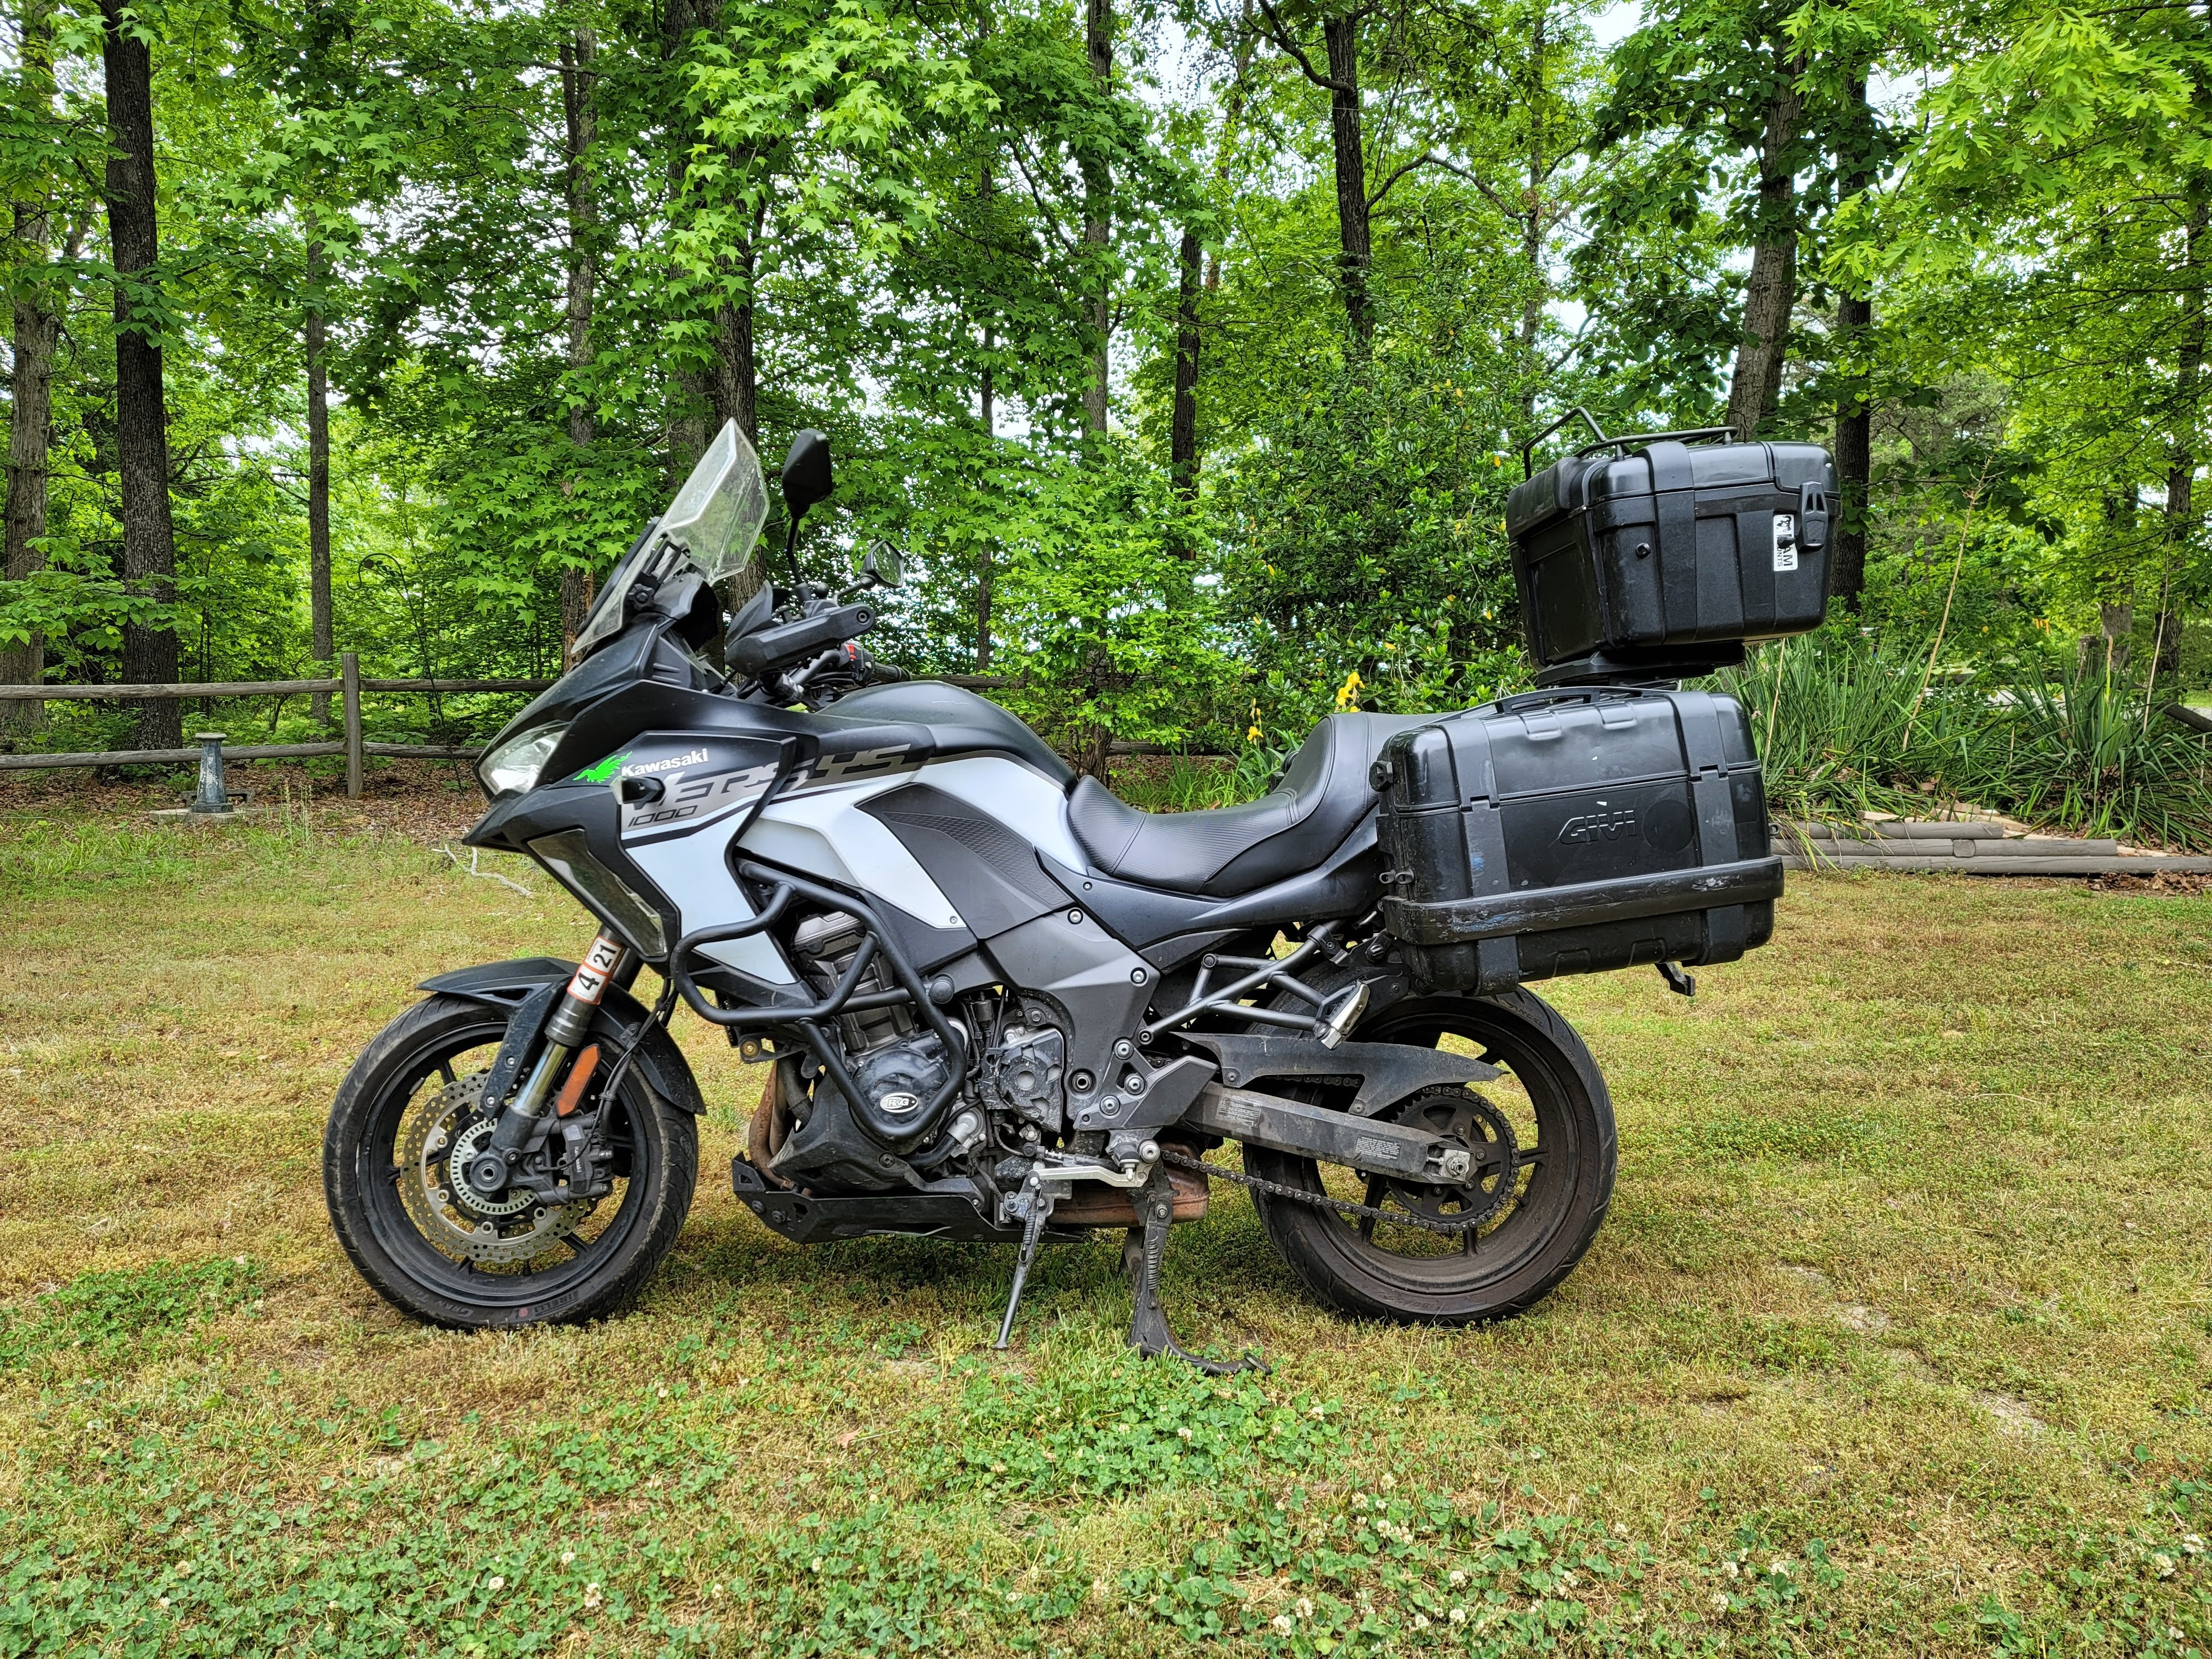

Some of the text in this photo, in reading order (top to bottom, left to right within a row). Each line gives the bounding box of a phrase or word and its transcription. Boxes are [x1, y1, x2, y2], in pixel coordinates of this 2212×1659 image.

[621, 748, 709, 777] Kawasaki
[628, 805, 698, 827] 1000
[1559, 810, 1637, 844] GIVI
[578, 972, 599, 990] 4
[593, 945, 617, 968] 21
[888, 1098, 909, 1107] R&G
